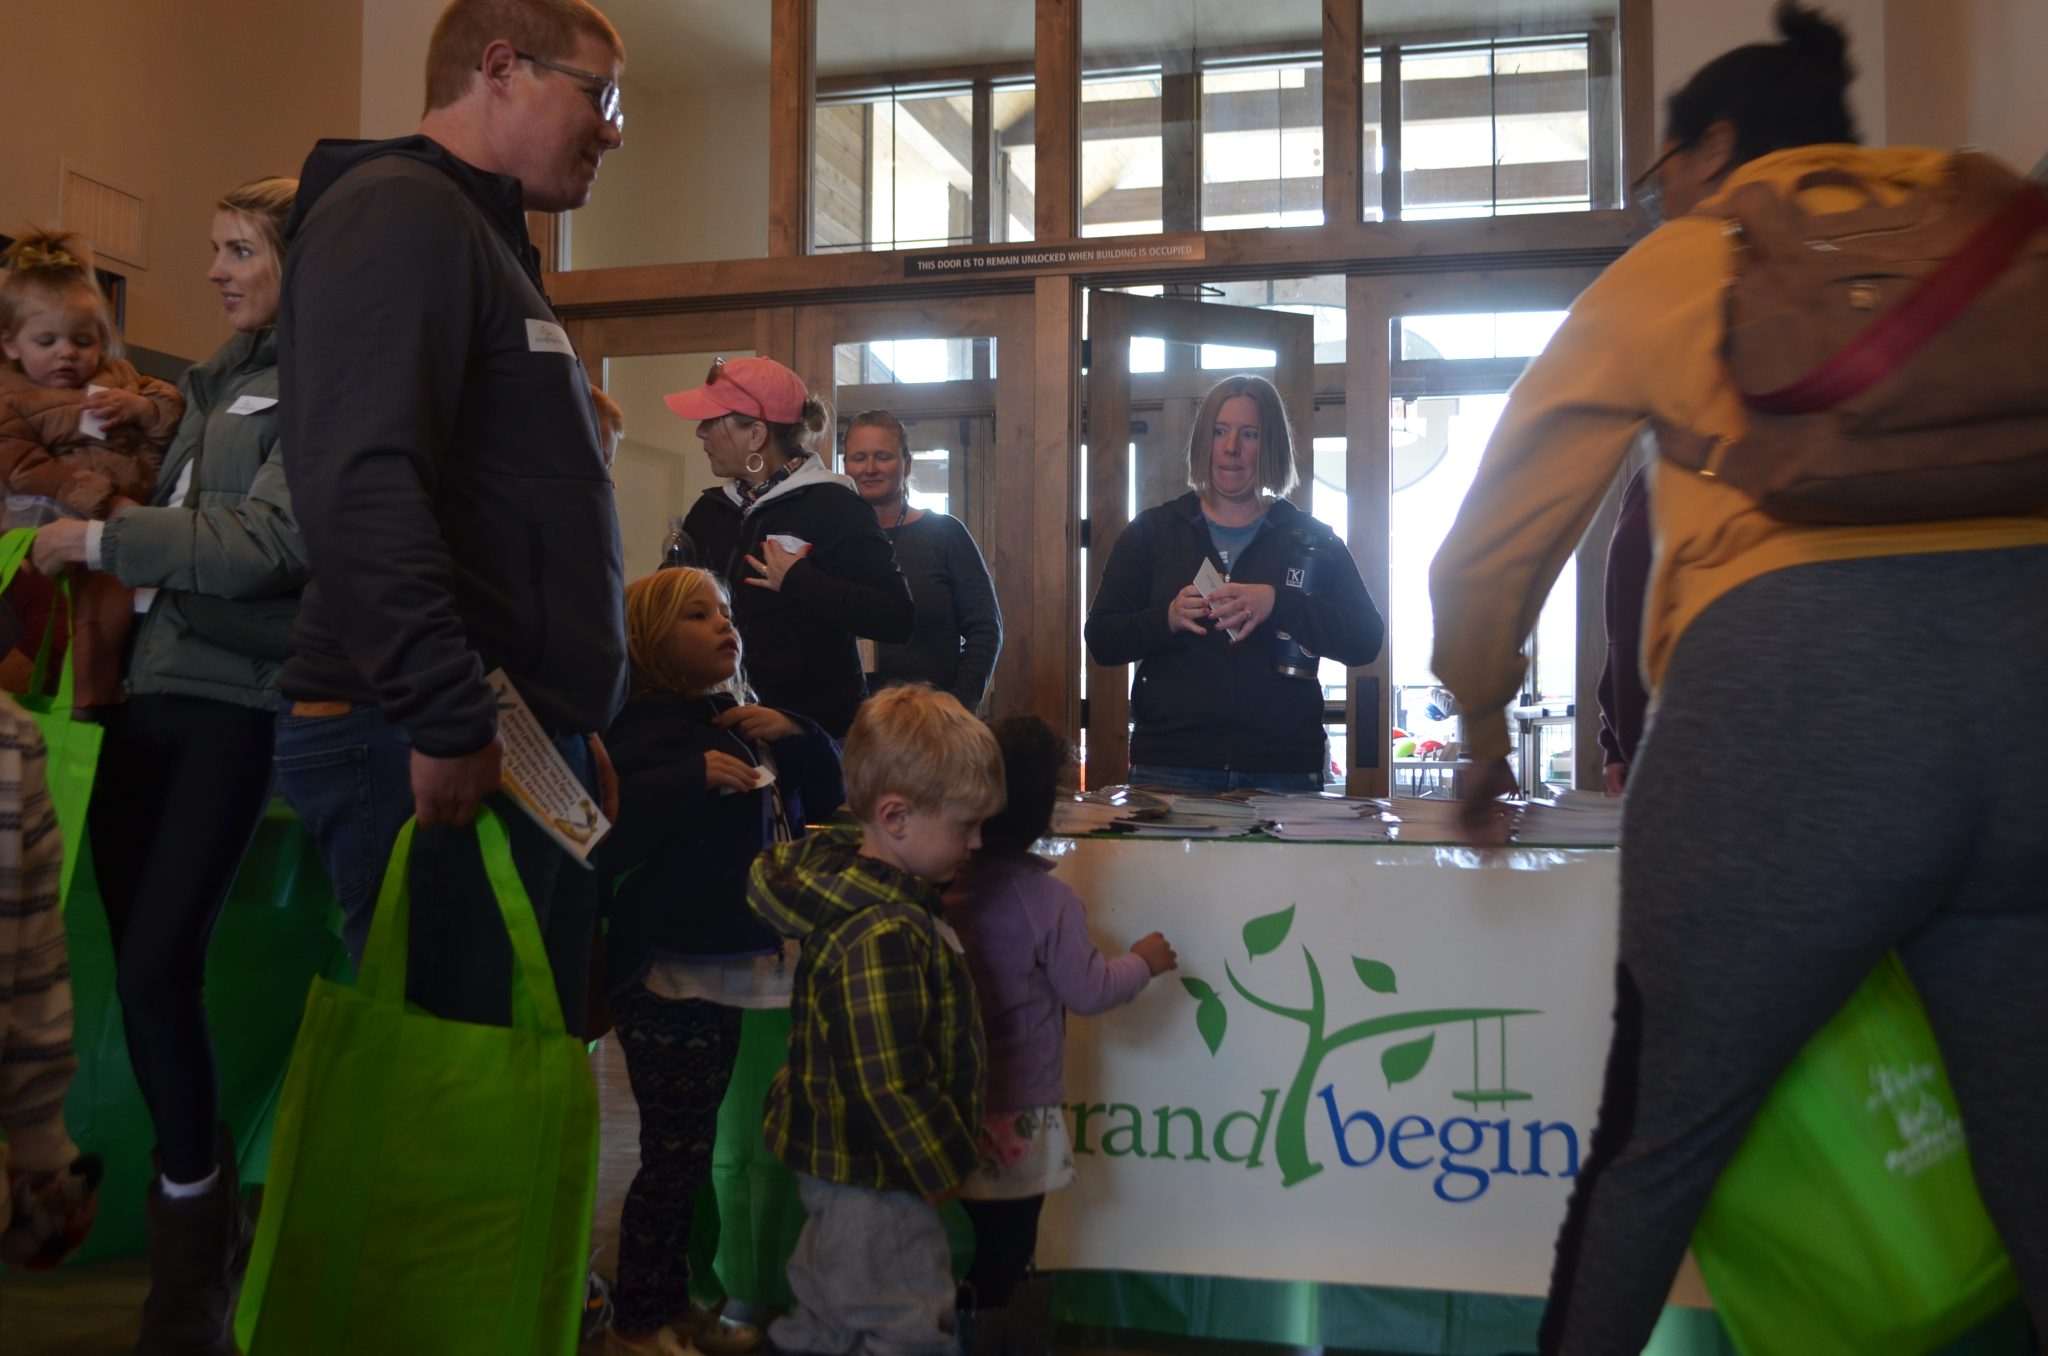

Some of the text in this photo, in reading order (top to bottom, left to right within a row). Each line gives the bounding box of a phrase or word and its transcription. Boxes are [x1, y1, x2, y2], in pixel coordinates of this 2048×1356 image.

[918, 245, 1193, 271] THIS DOOR IS TO REMAIN UNLOCKED WHEN BUILDING IS OCCUPIED
[521, 734, 534, 749] and
[530, 746, 550, 771] Prizes
[510, 764, 526, 782] July
[522, 779, 551, 814] Saturday
[557, 781, 576, 806] Family
[1061, 1083, 1600, 1203] rand begin
